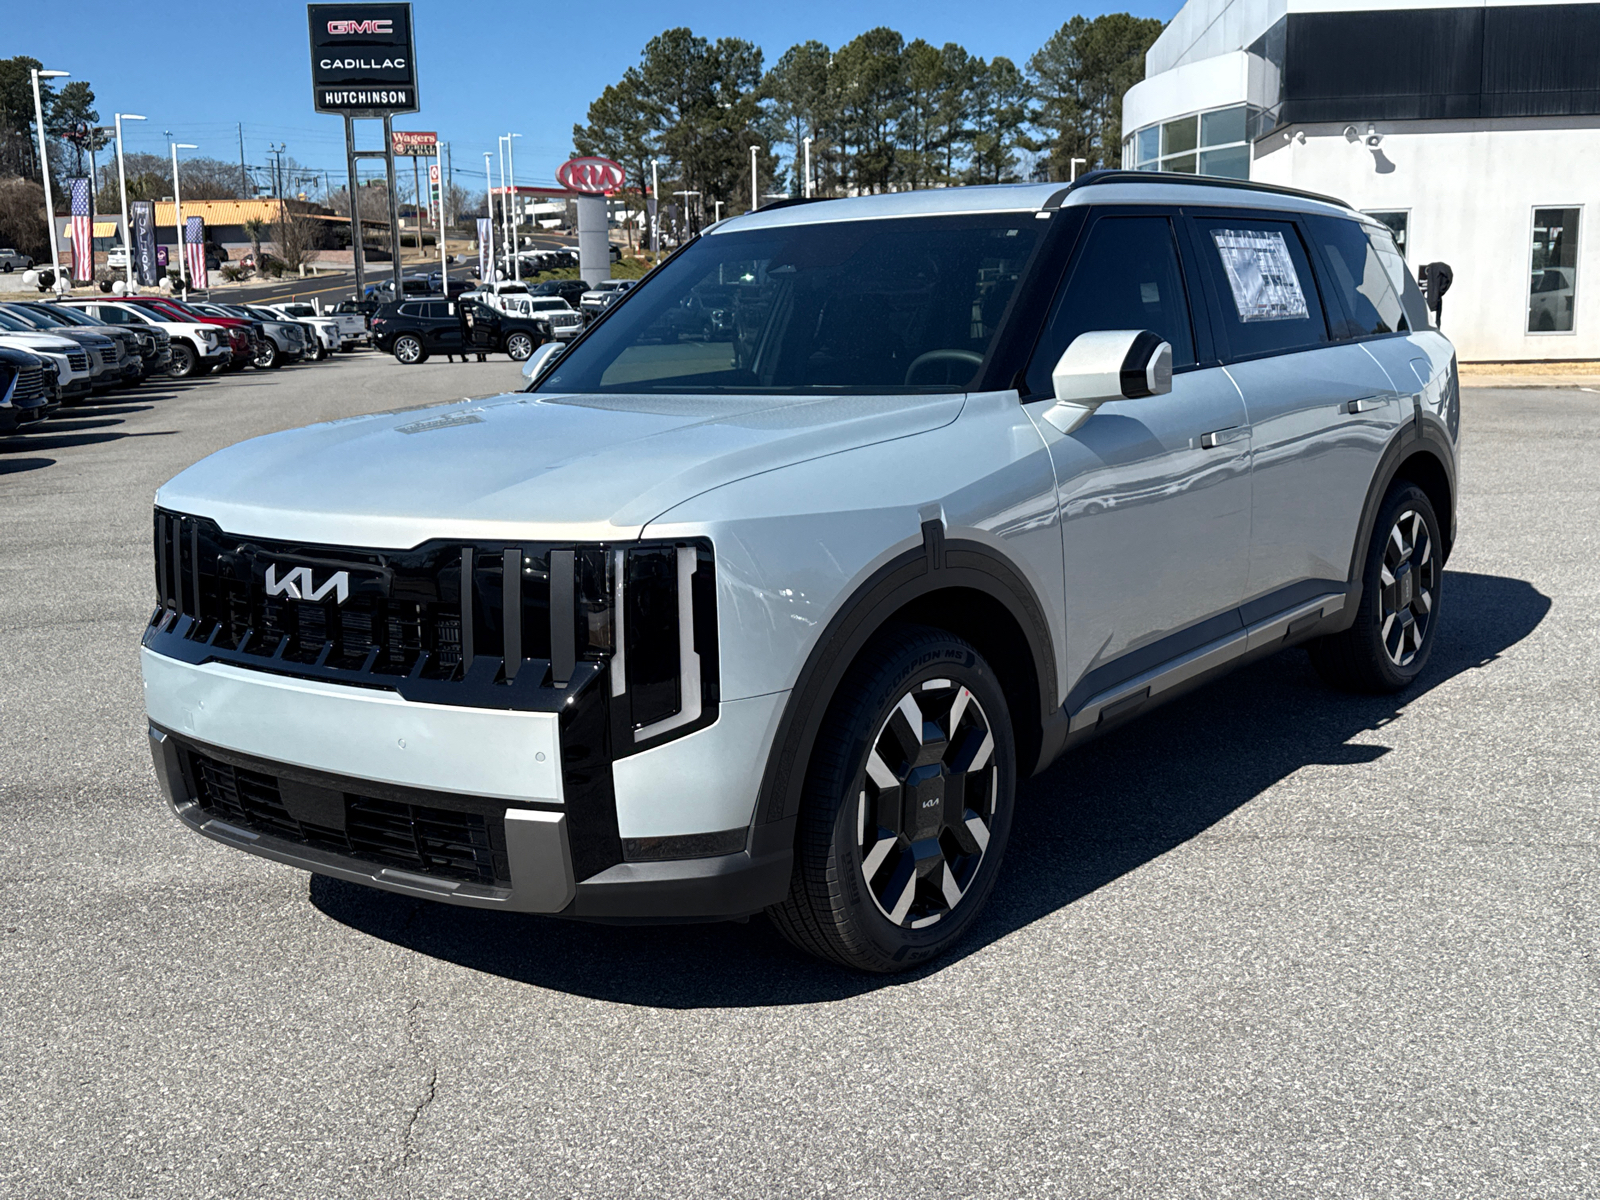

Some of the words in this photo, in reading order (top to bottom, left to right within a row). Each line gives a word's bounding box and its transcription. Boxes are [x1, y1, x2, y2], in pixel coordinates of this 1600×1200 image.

[327, 20, 393, 34] GMC
[320, 59, 405, 69] CADILLAC
[325, 91, 406, 104] HUTCHINSON
[393, 132, 435, 145] Wagers
[570, 164, 614, 185] KIA
[265, 563, 349, 604] KIA
